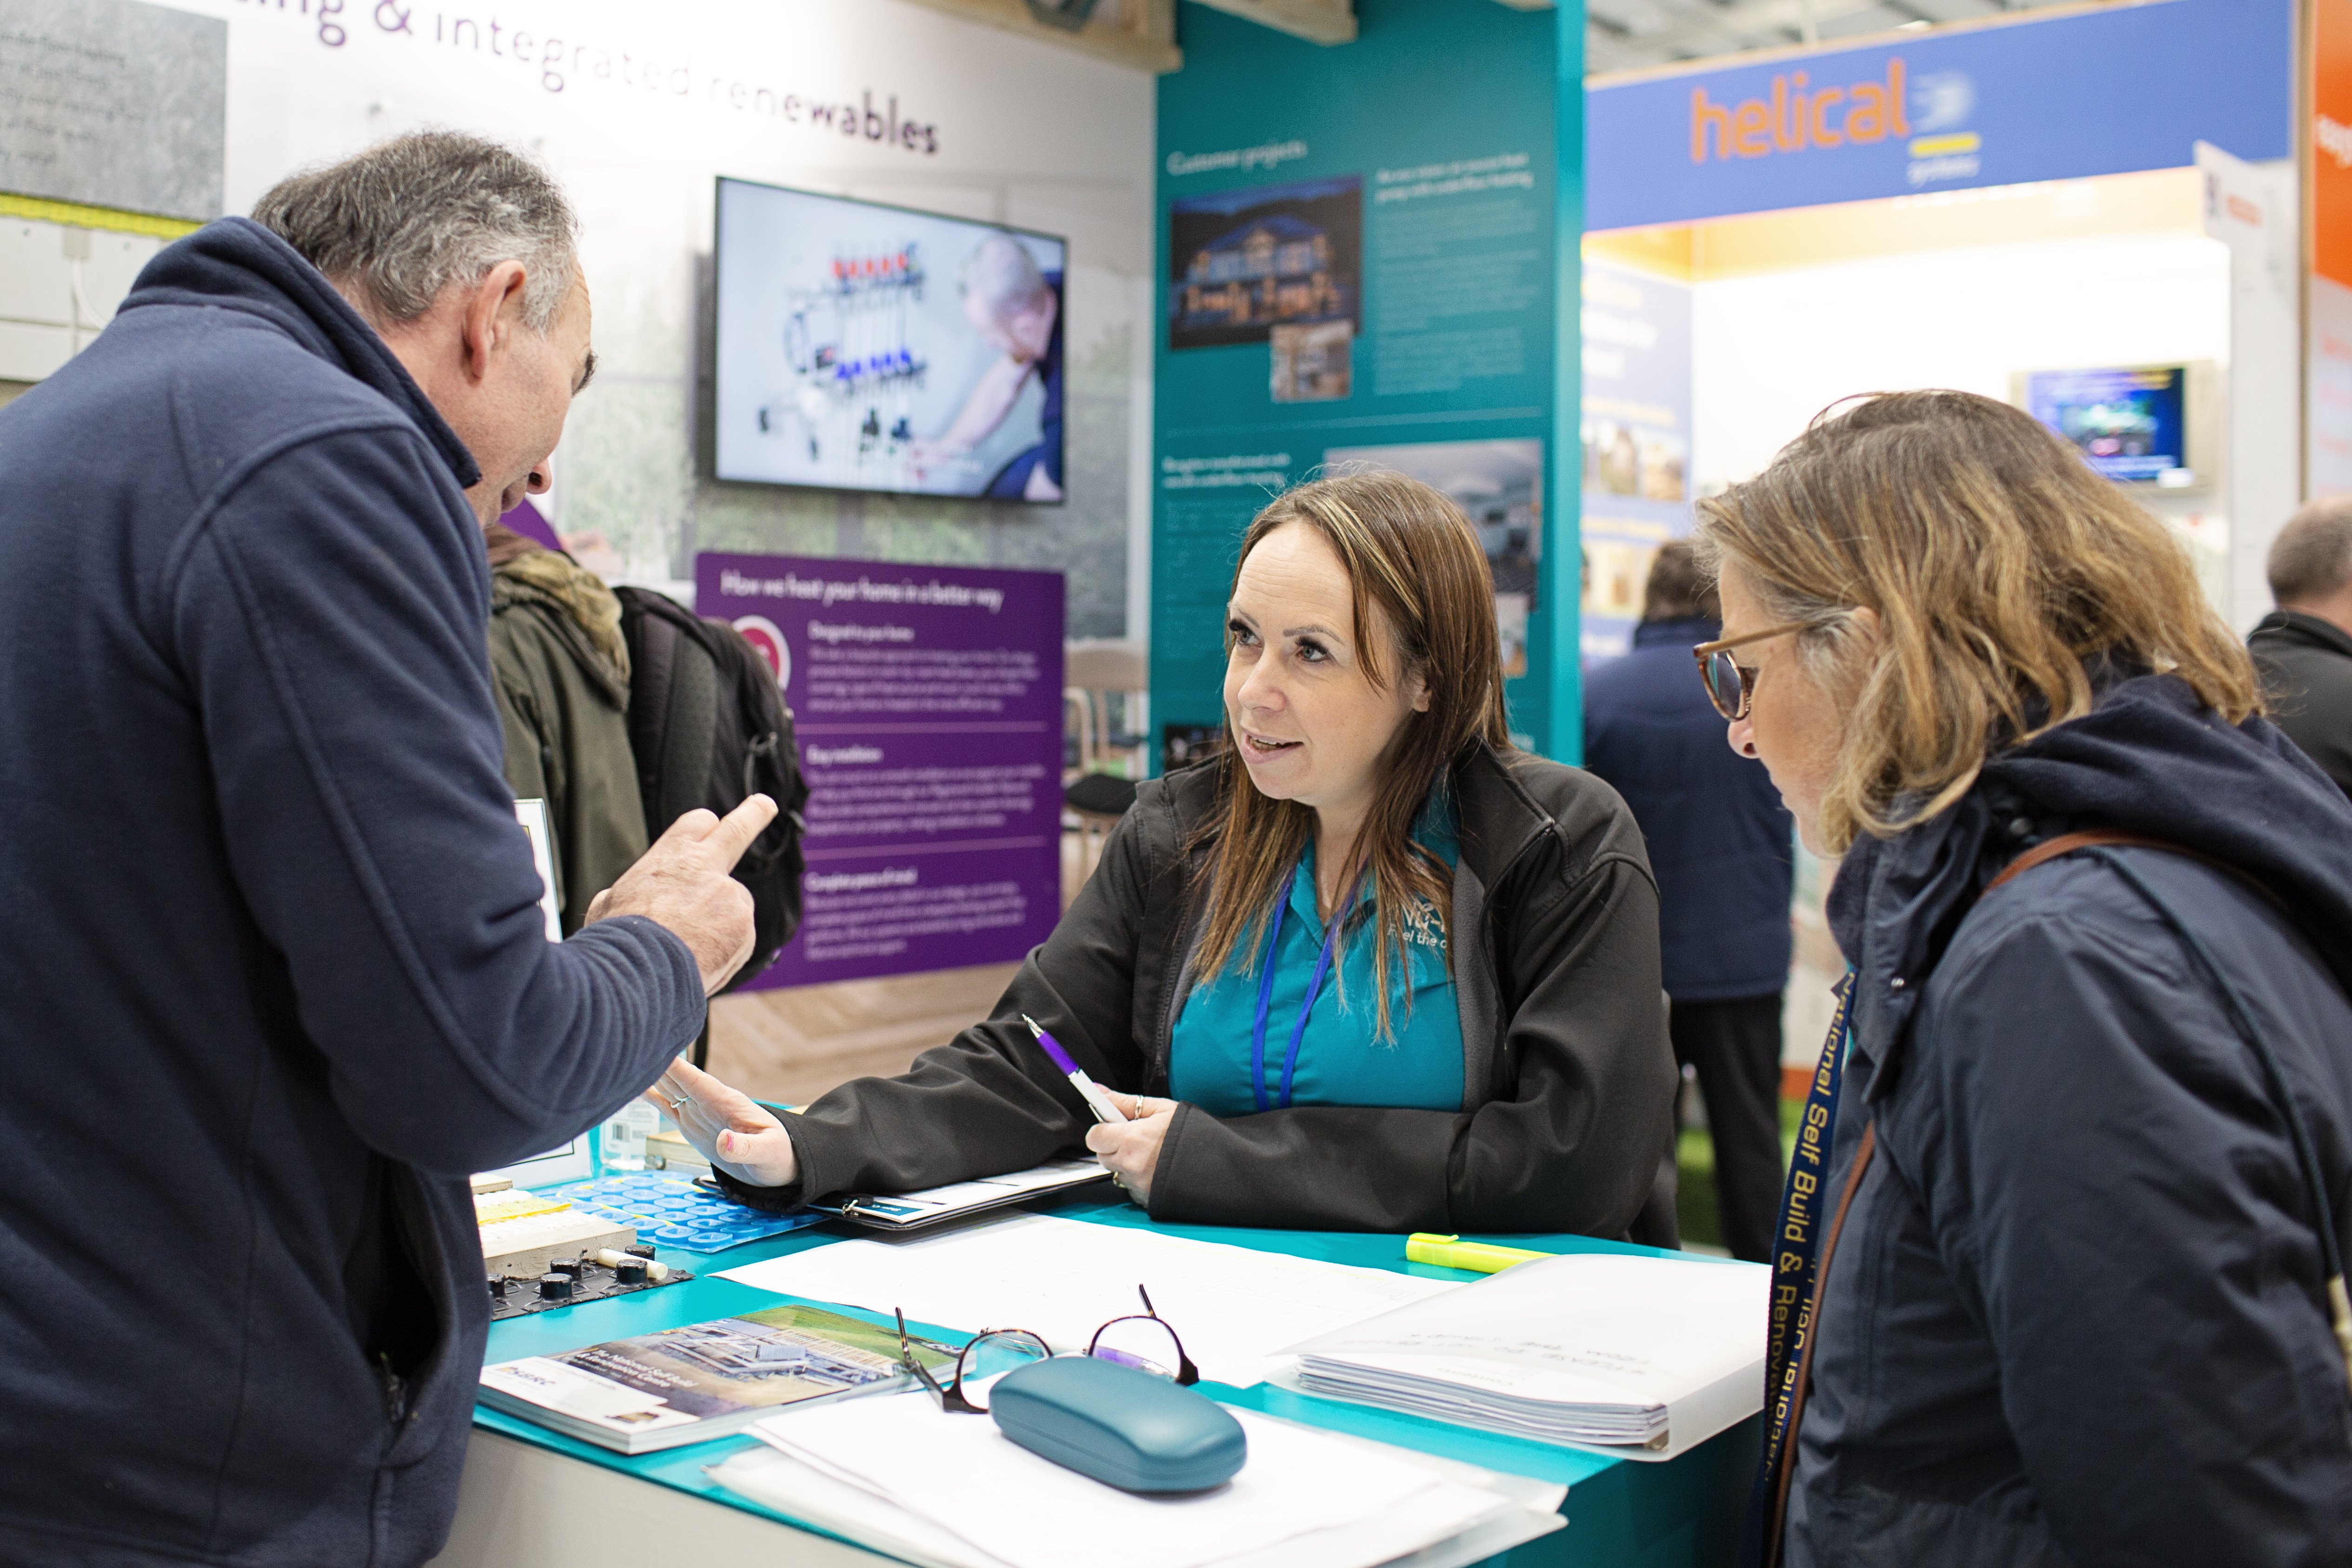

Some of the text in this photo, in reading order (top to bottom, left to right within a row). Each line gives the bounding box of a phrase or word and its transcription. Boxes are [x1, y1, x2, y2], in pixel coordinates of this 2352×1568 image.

[436, 12, 691, 94] integrated
[709, 76, 940, 156] renewables
[1690, 57, 1911, 165] helical
[721, 569, 761, 597] How
[762, 577, 785, 598] we
[786, 572, 823, 599] heat
[823, 580, 858, 607] your
[859, 575, 902, 603] home
[903, 578, 918, 603] in
[930, 579, 974, 605] better
[974, 588, 1003, 614] way
[1416, 930, 1438, 947] the
[1815, 972, 1855, 1096] National
[1799, 1103, 1828, 1166] Self
[1784, 1169, 1818, 1243] Build
[1778, 1251, 1804, 1275] &
[585, 1355, 639, 1376] Renovation
[637, 1373, 671, 1388] Centre
[591, 1349, 610, 1359] The
[607, 1354, 657, 1372] National
[666, 1374, 699, 1388] Build
